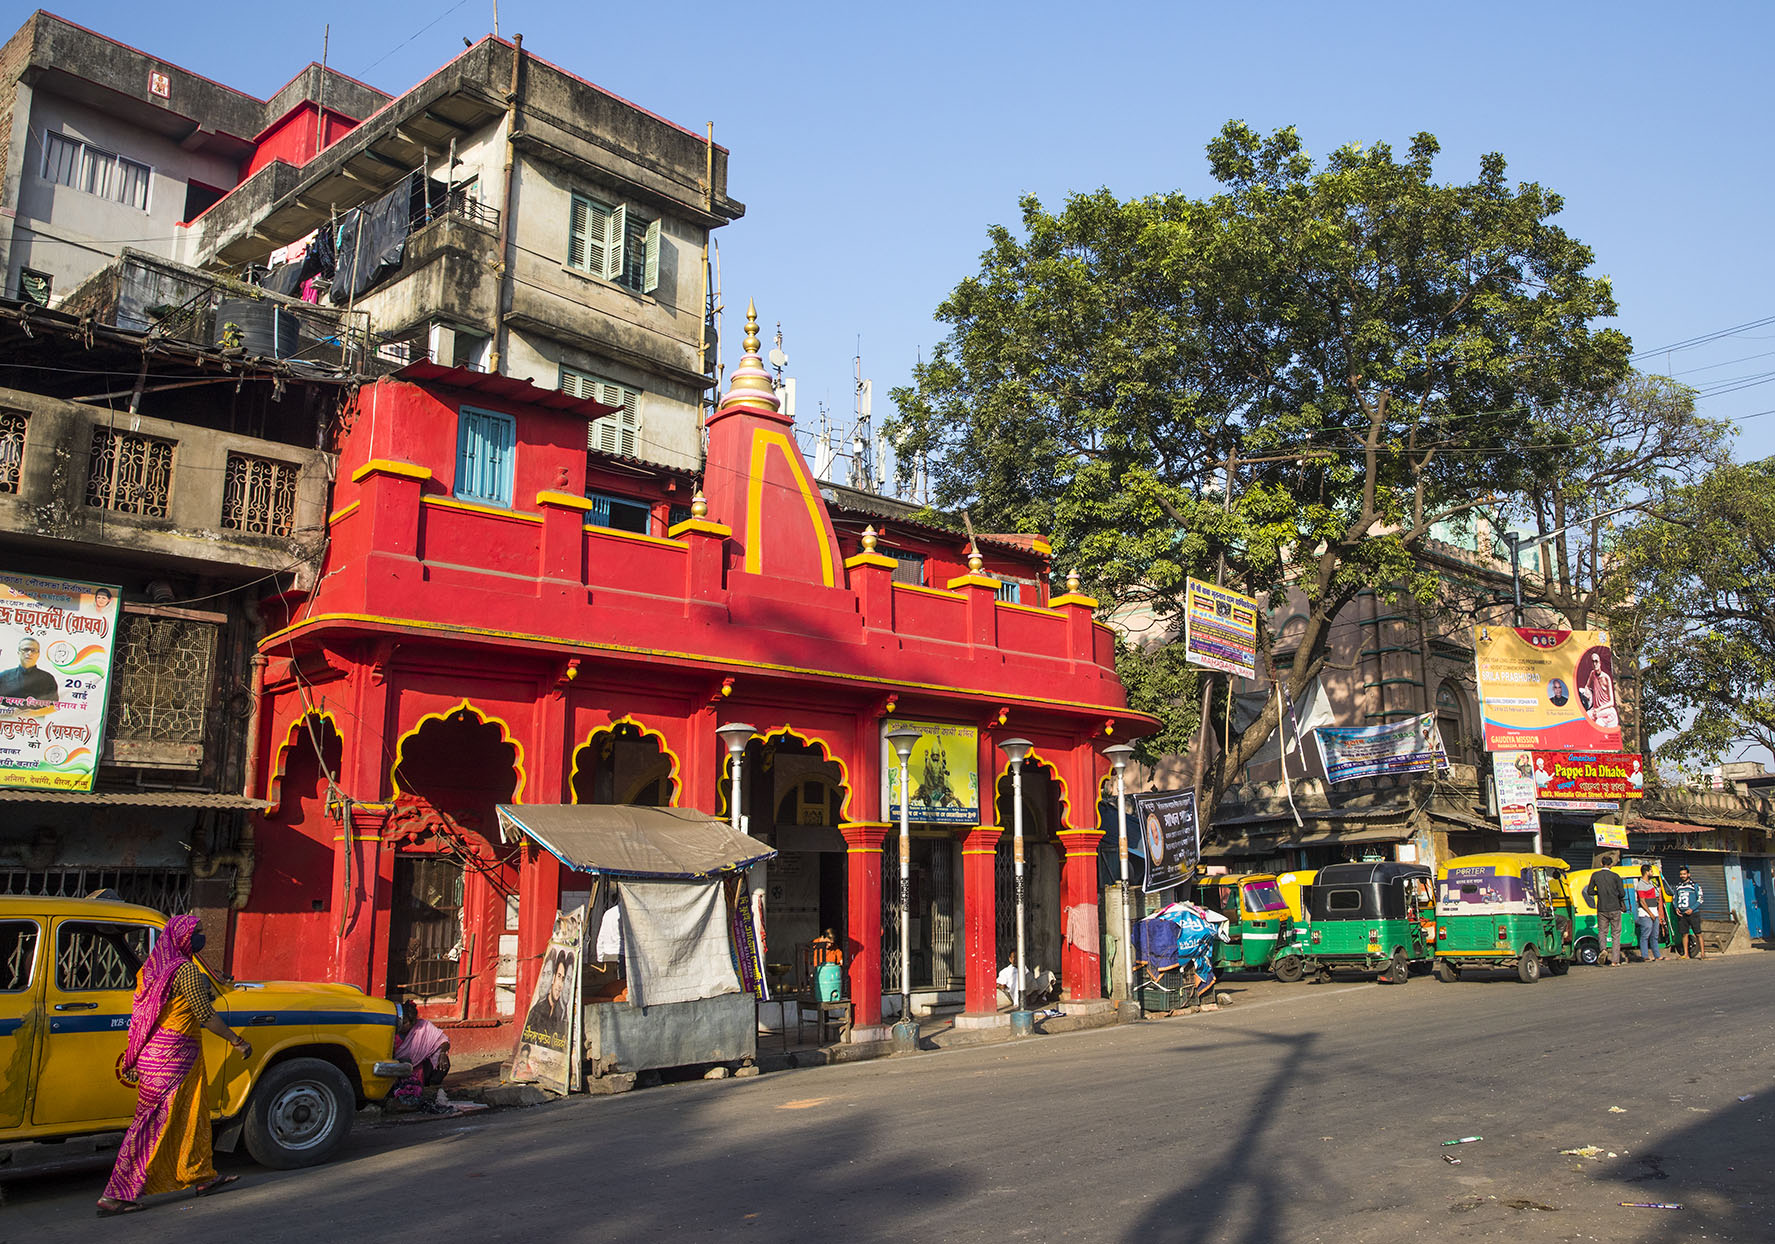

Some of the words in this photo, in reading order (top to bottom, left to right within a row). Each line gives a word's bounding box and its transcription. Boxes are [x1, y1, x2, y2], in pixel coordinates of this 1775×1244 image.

[1482, 671, 1500, 681] SRILA
[1501, 672, 1541, 682] PRABHUPAD
[65, 679, 82, 689] 20
[72, 690, 88, 700] वार्ड
[5, 697, 25, 706] नगर
[53, 701, 77, 711] चुनाव
[80, 701, 88, 711] में
[45, 720, 91, 746] (राघव)
[28, 739, 41, 749] को
[1490, 735, 1516, 744] GAUDIYA
[1516, 736, 1540, 744] MISSION
[1568, 753, 1597, 762] Amantran
[1554, 763, 1583, 780] Pappe
[1584, 764, 1597, 777] Da
[1598, 764, 1626, 778] Dhaba
[1455, 866, 1486, 876] PORTER
